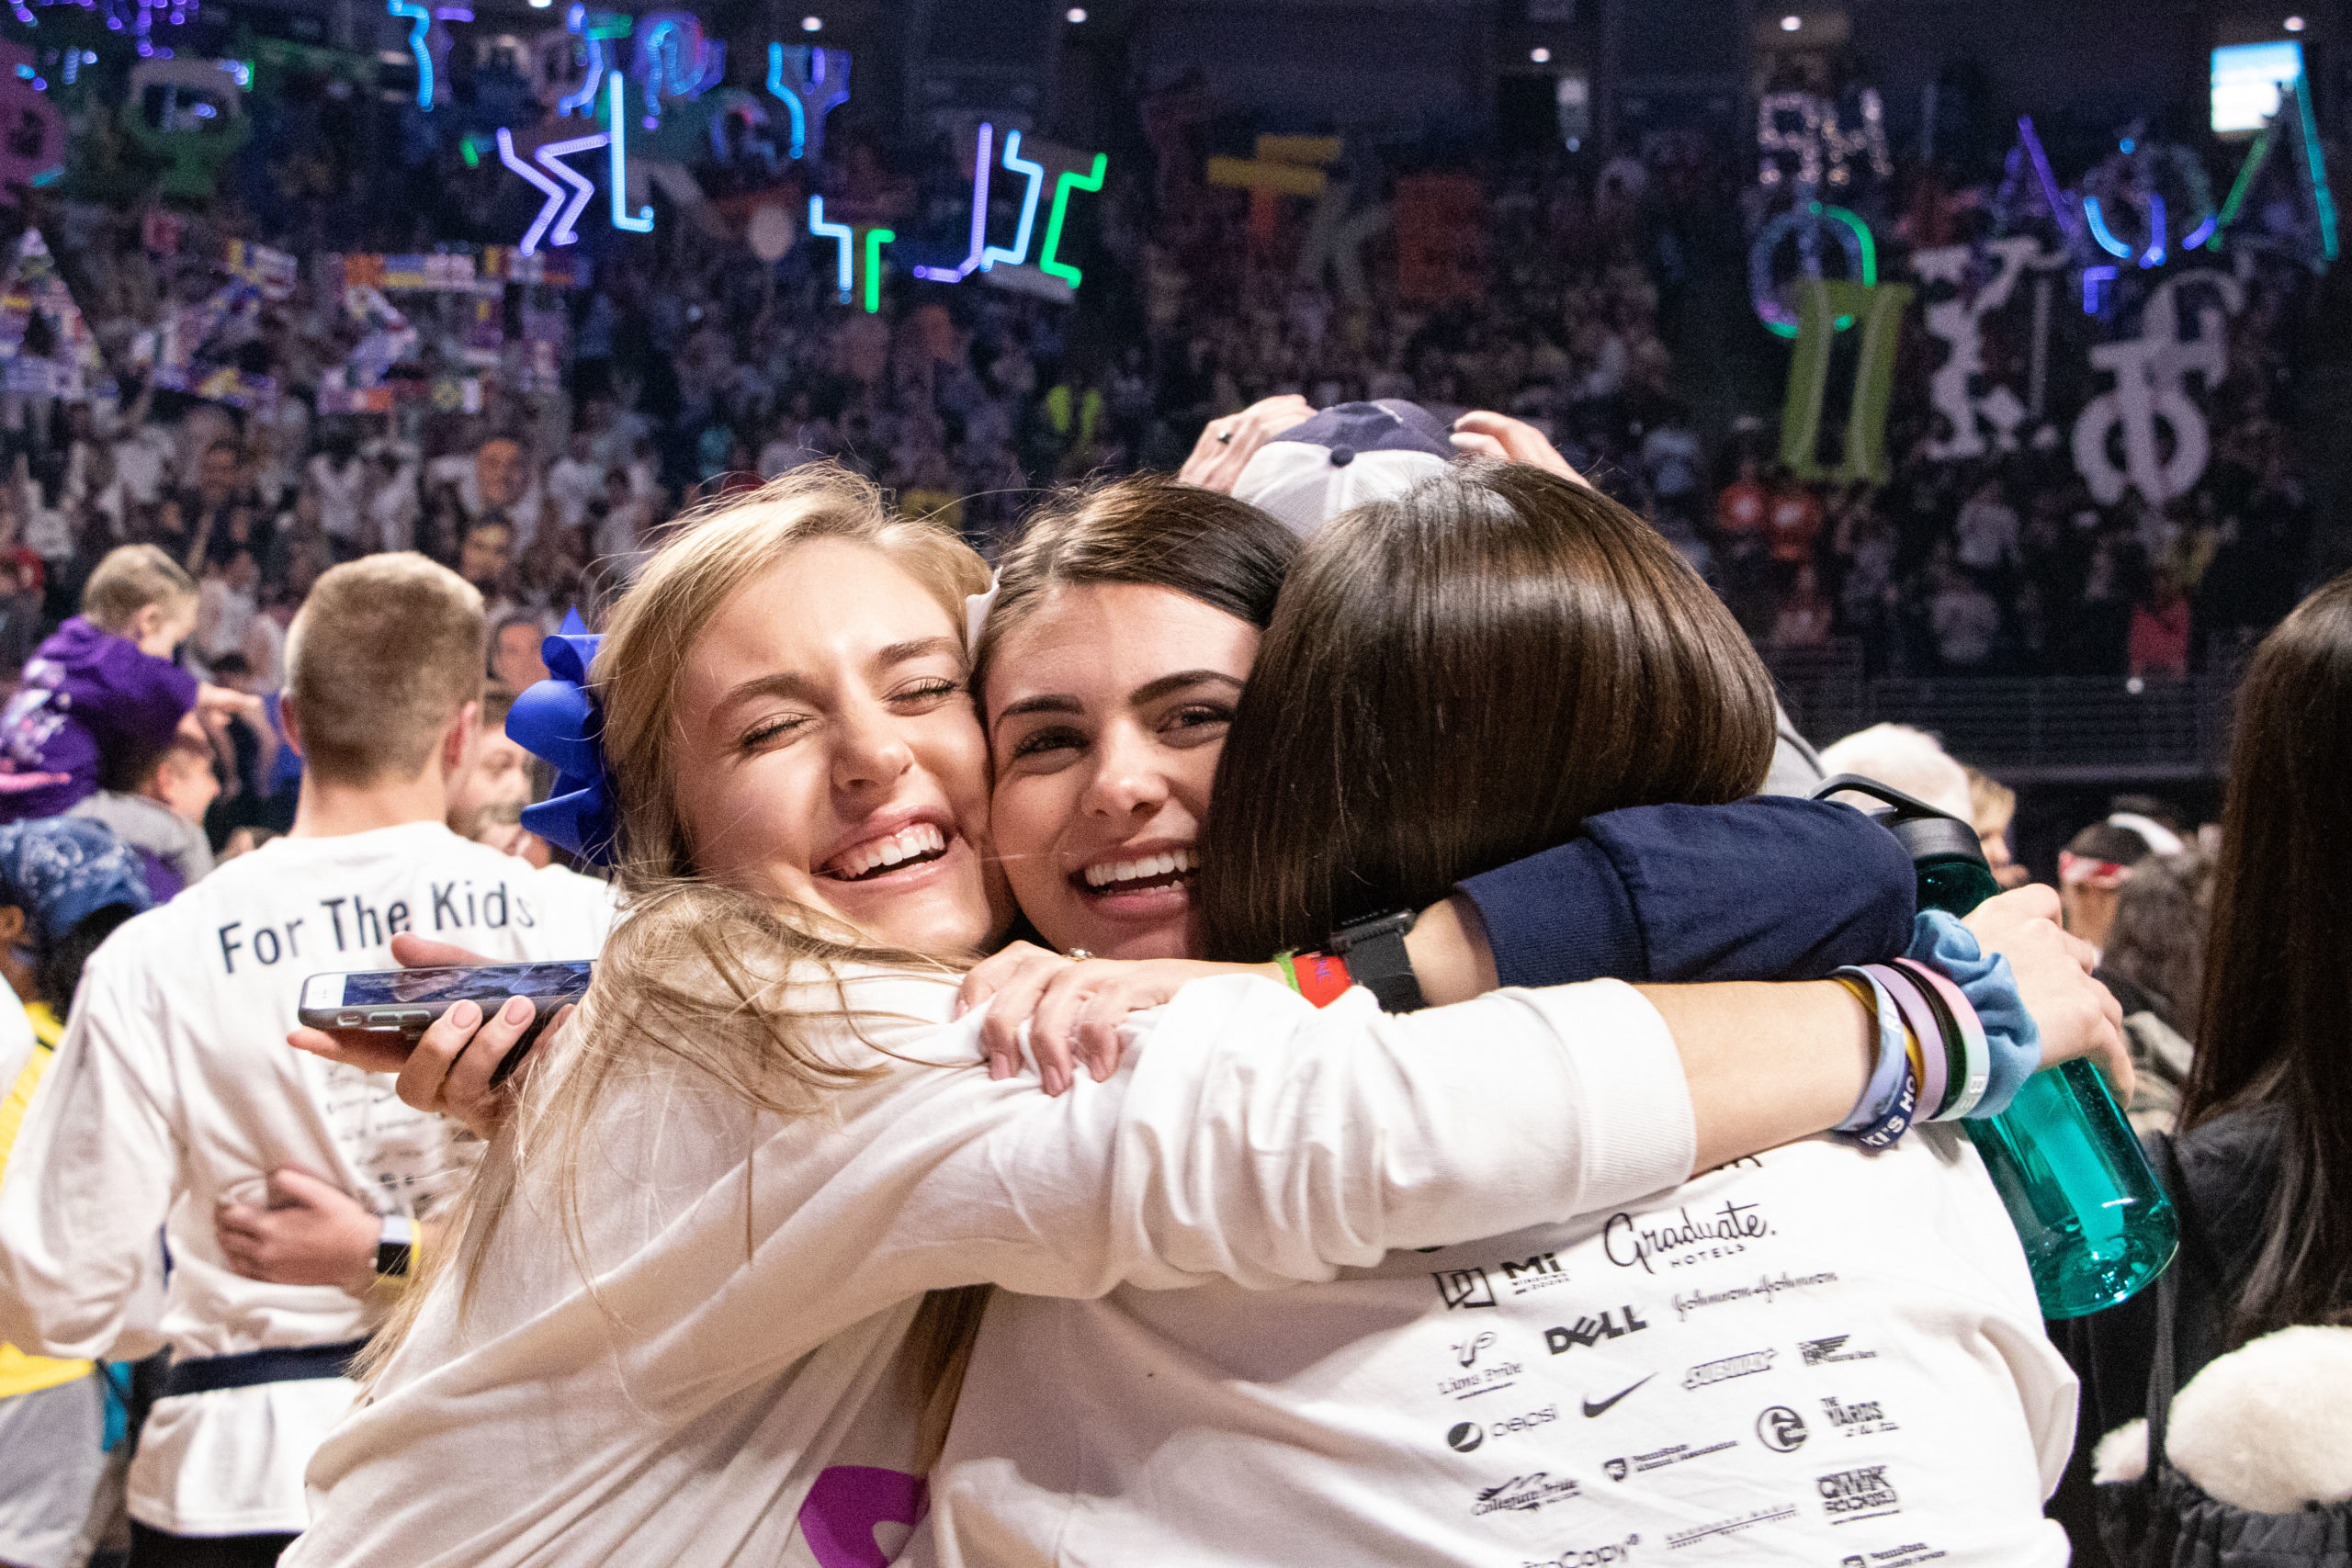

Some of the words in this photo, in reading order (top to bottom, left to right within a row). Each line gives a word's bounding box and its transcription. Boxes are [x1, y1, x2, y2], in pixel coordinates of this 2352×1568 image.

[218, 921, 304, 975] For
[320, 891, 411, 952] The
[430, 879, 535, 931] Kids
[1670, 1243, 1747, 1268] HOTELS
[1544, 1304, 1648, 1356] DELL
